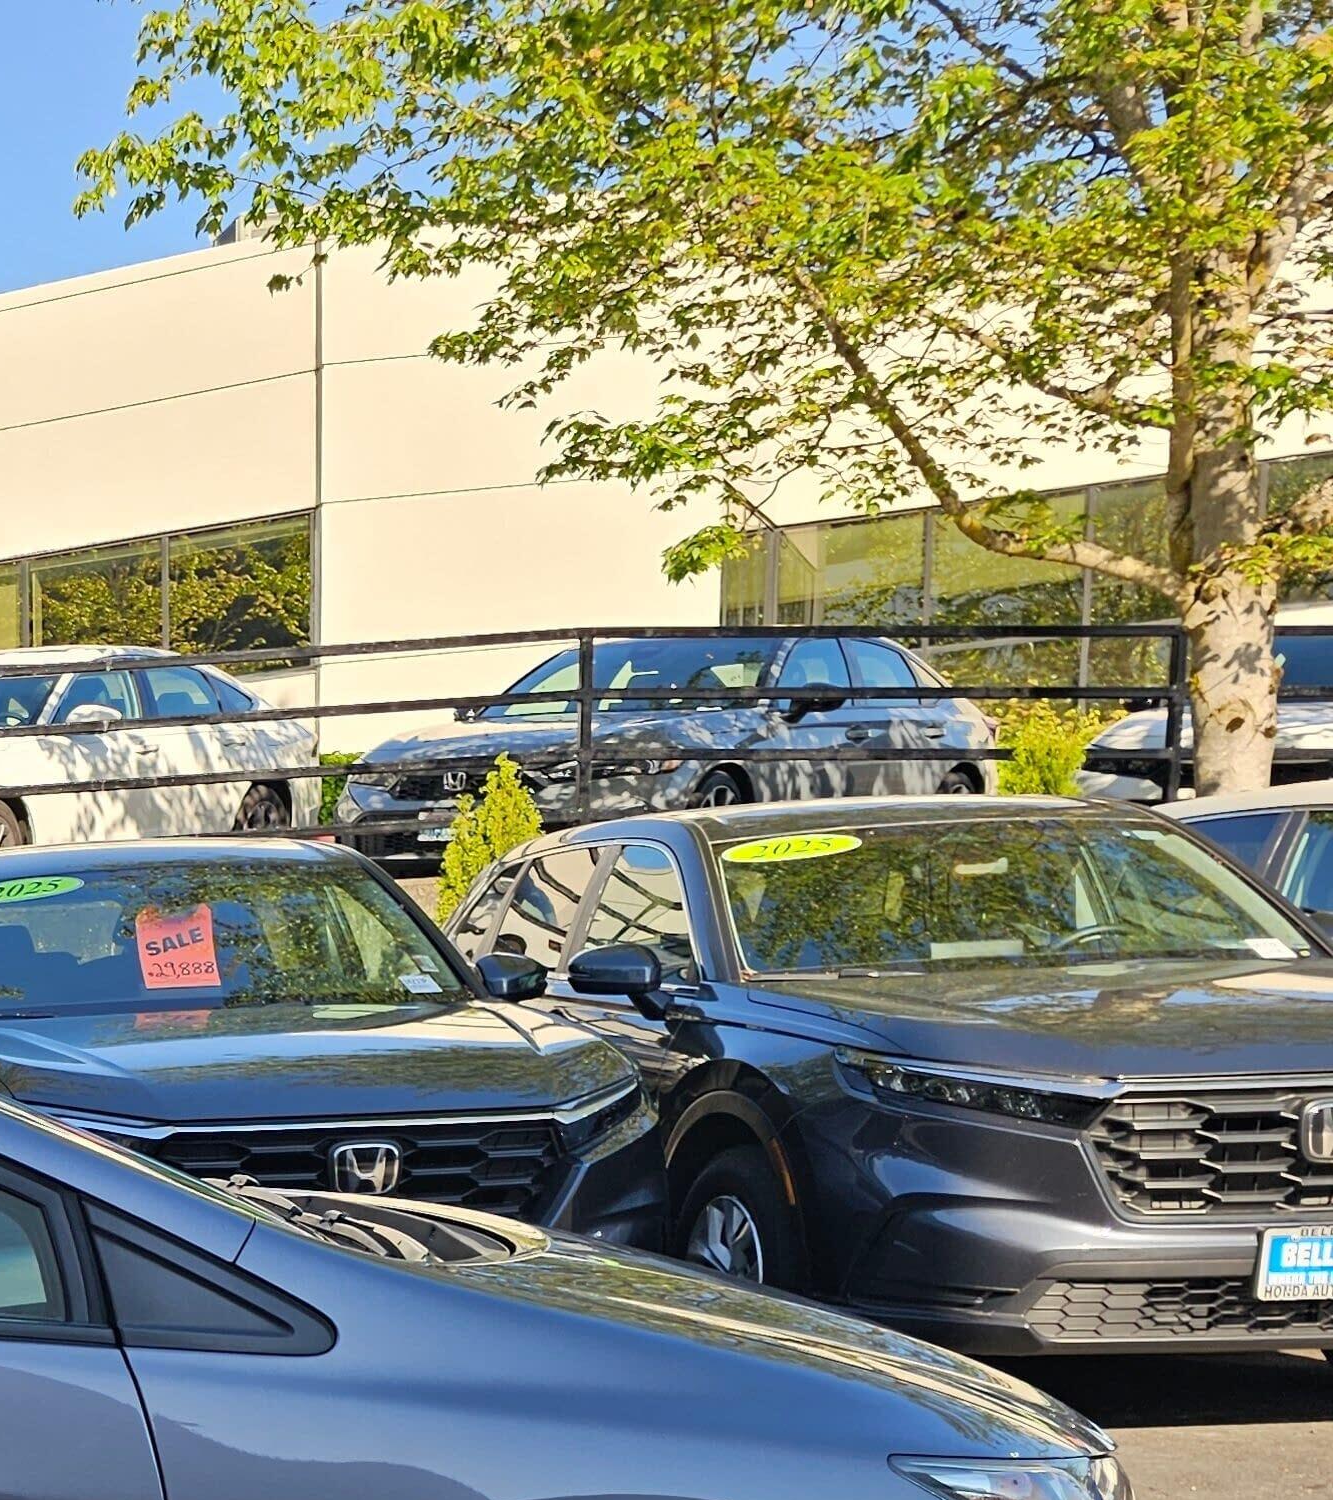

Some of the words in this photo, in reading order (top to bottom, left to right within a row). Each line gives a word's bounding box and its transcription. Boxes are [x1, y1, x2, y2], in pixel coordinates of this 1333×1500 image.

[750, 838, 834, 858] 2025
[145, 927, 204, 956] SALE
[1264, 1284, 1308, 1298] HONDA
